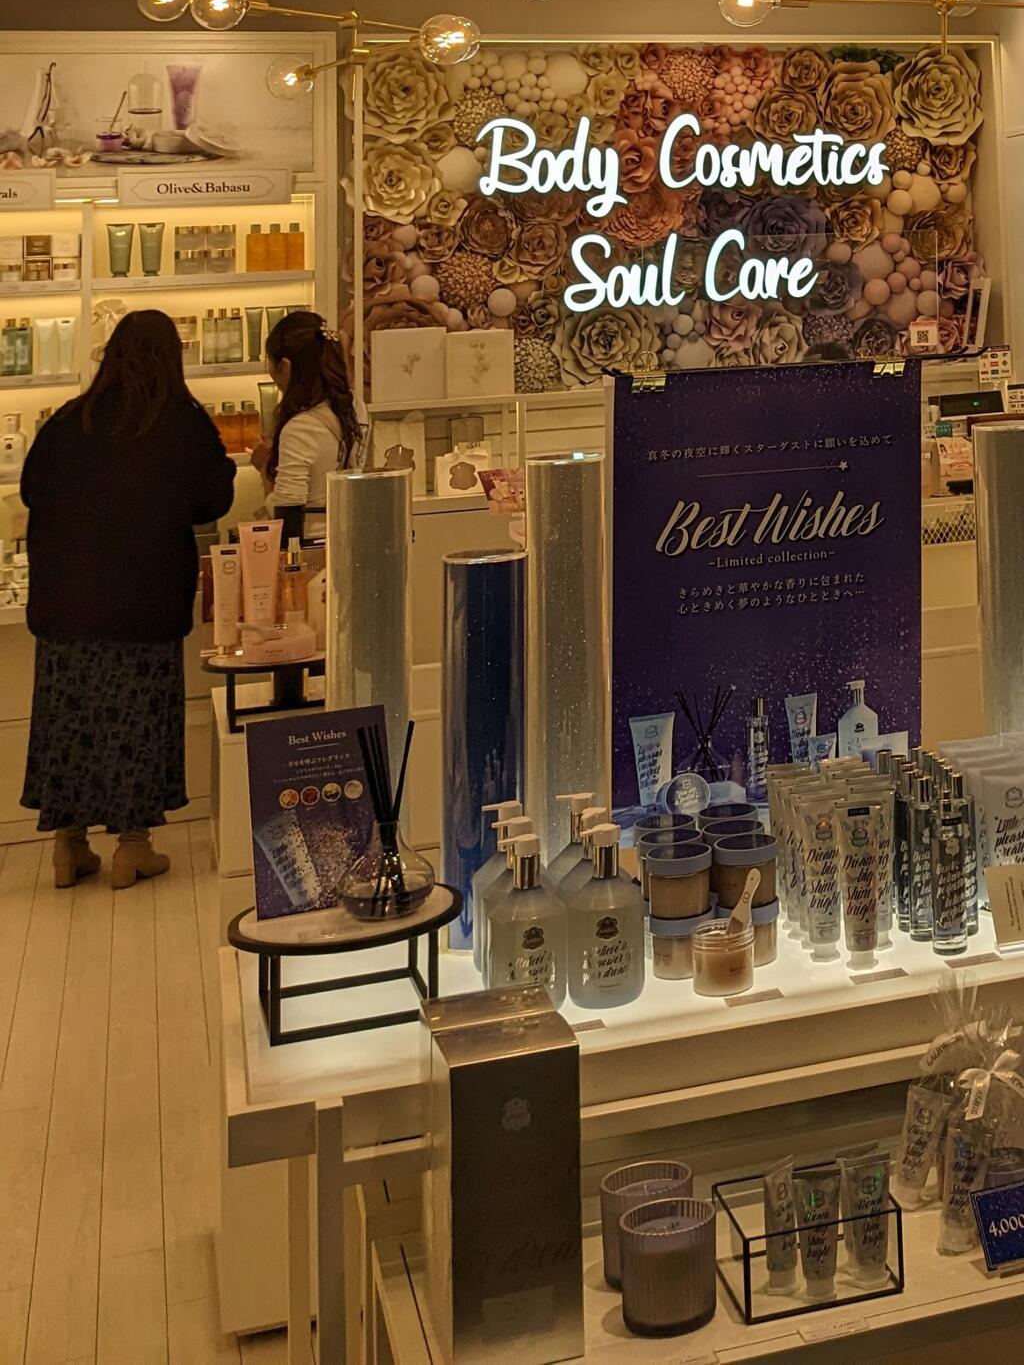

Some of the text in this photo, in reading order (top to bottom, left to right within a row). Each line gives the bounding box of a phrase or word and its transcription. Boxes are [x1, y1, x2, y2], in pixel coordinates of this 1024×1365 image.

[475, 113, 890, 217] Body Cosmetics
[563, 228, 818, 313] Soul Care
[655, 490, 885, 556] Best Wishes
[288, 729, 347, 746] Best Wishes
